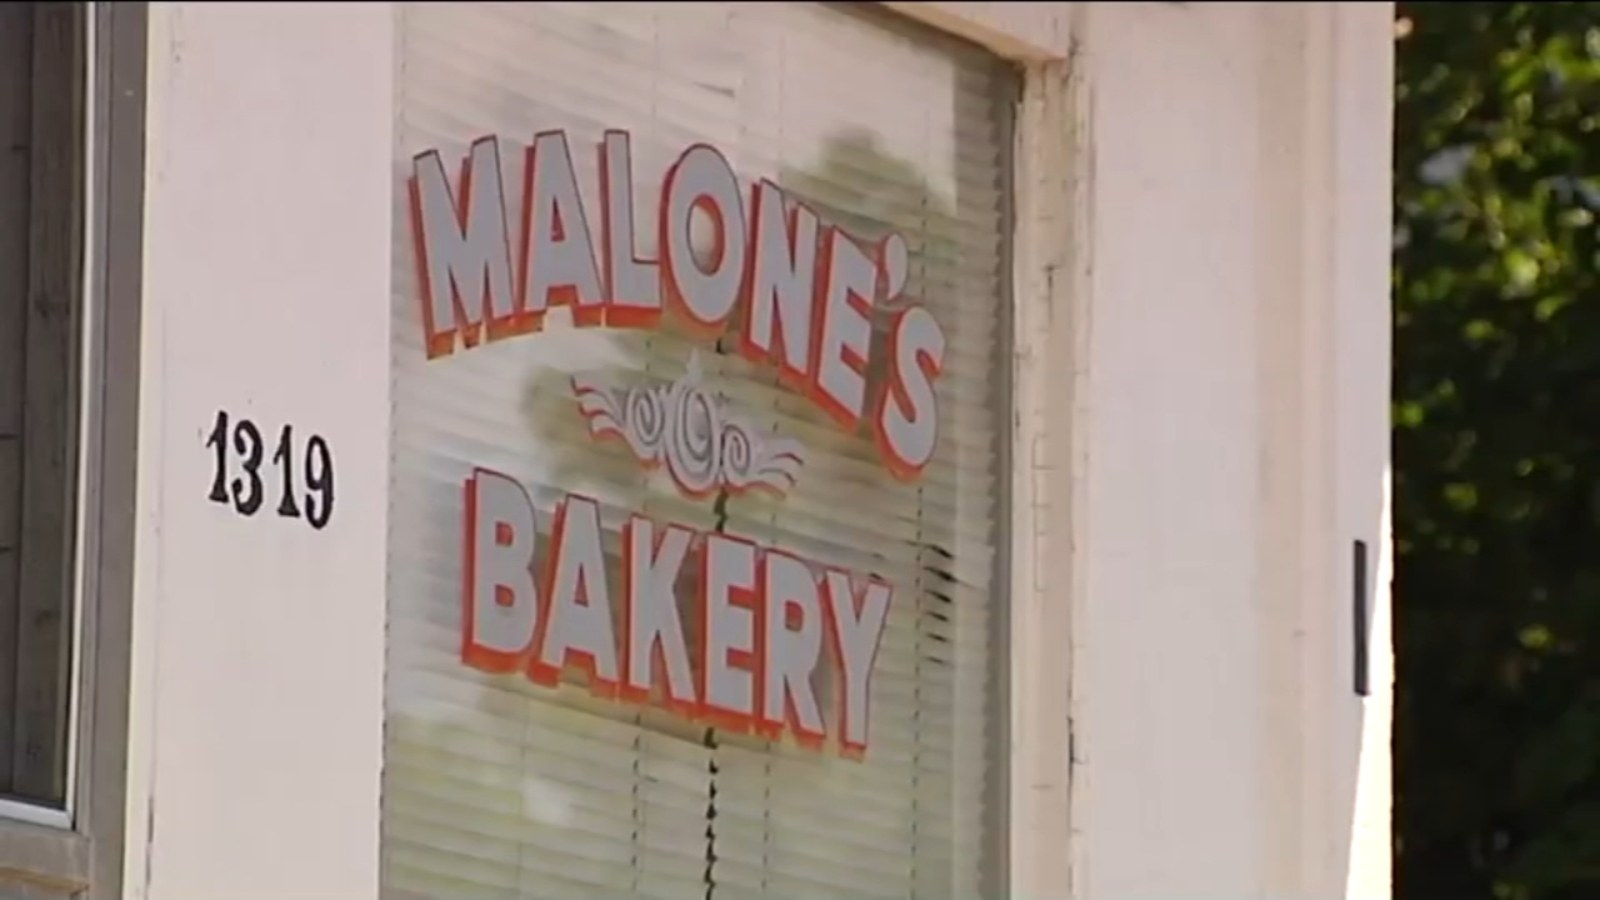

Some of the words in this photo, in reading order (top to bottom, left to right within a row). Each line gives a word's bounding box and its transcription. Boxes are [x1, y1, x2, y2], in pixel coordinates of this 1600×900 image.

[408, 129, 945, 479] MALONE'S
[206, 410, 334, 530] 1319
[461, 467, 892, 759] BAKERY
